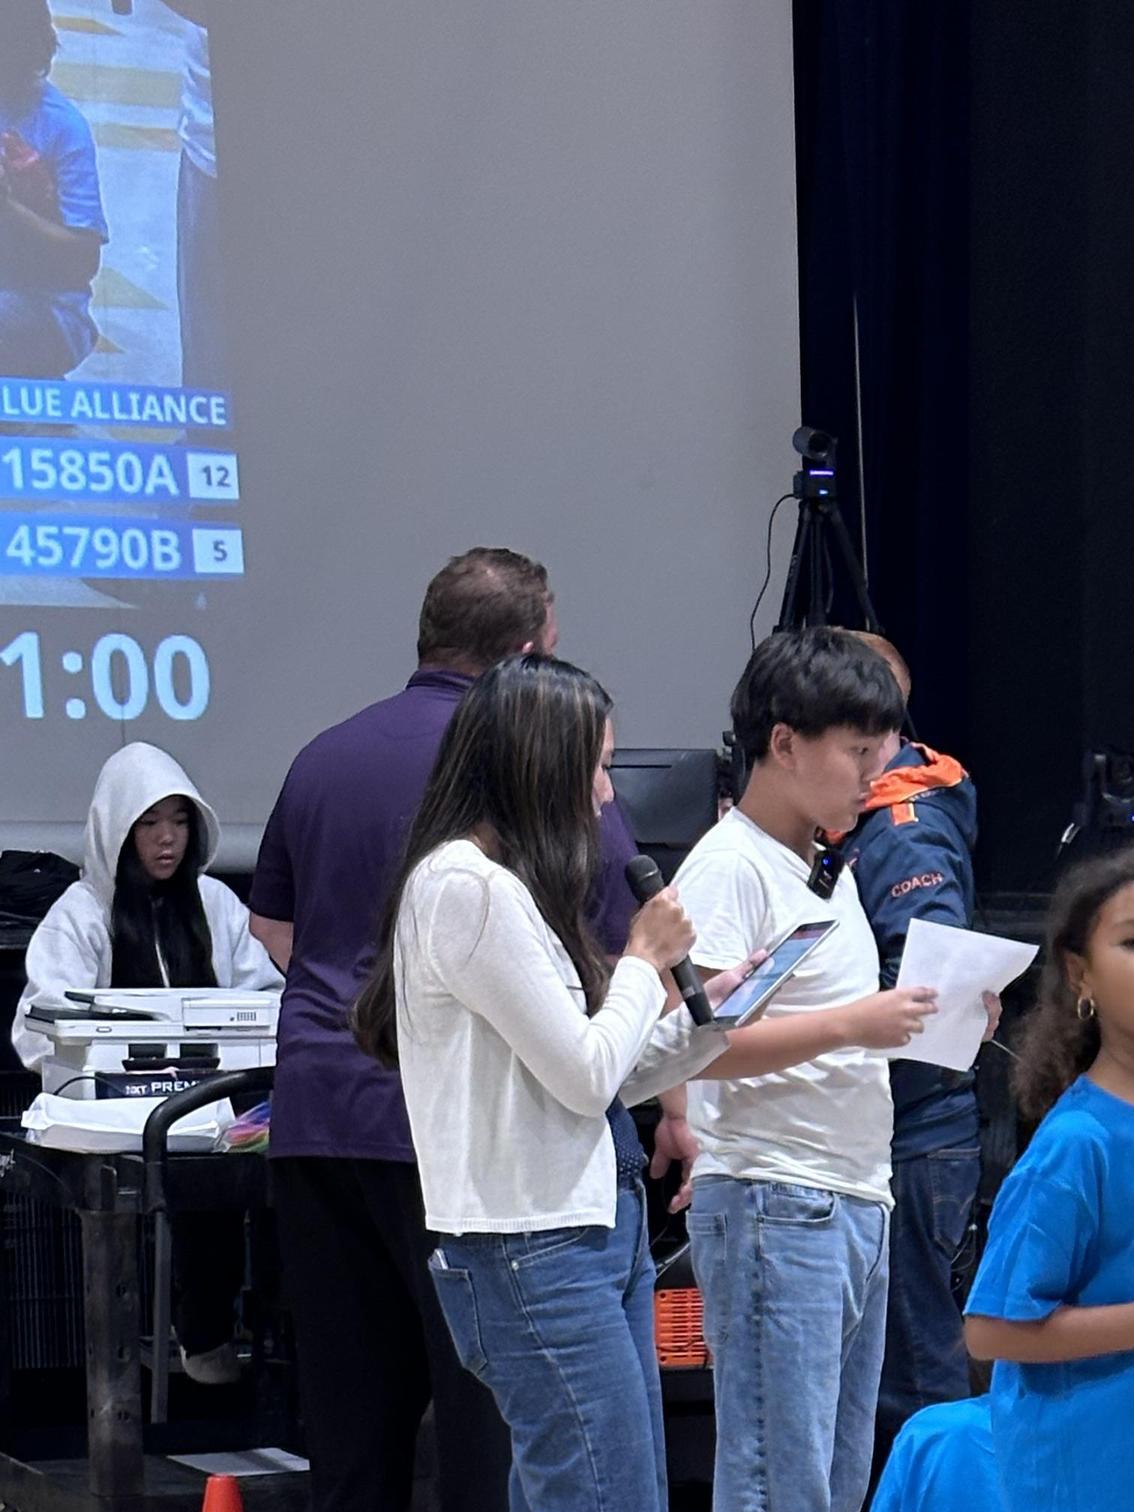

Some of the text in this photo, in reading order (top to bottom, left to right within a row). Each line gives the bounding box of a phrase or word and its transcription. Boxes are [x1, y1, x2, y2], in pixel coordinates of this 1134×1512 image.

[1, 384, 227, 426] LUE ALLIANCE
[1, 449, 180, 496] 15850A
[200, 465, 232, 488] 12
[6, 525, 182, 571] 45790B
[212, 540, 228, 563] 5
[0, 632, 211, 721] 1:00
[890, 872, 943, 898] COACH
[151, 1080, 199, 1092] PREM
